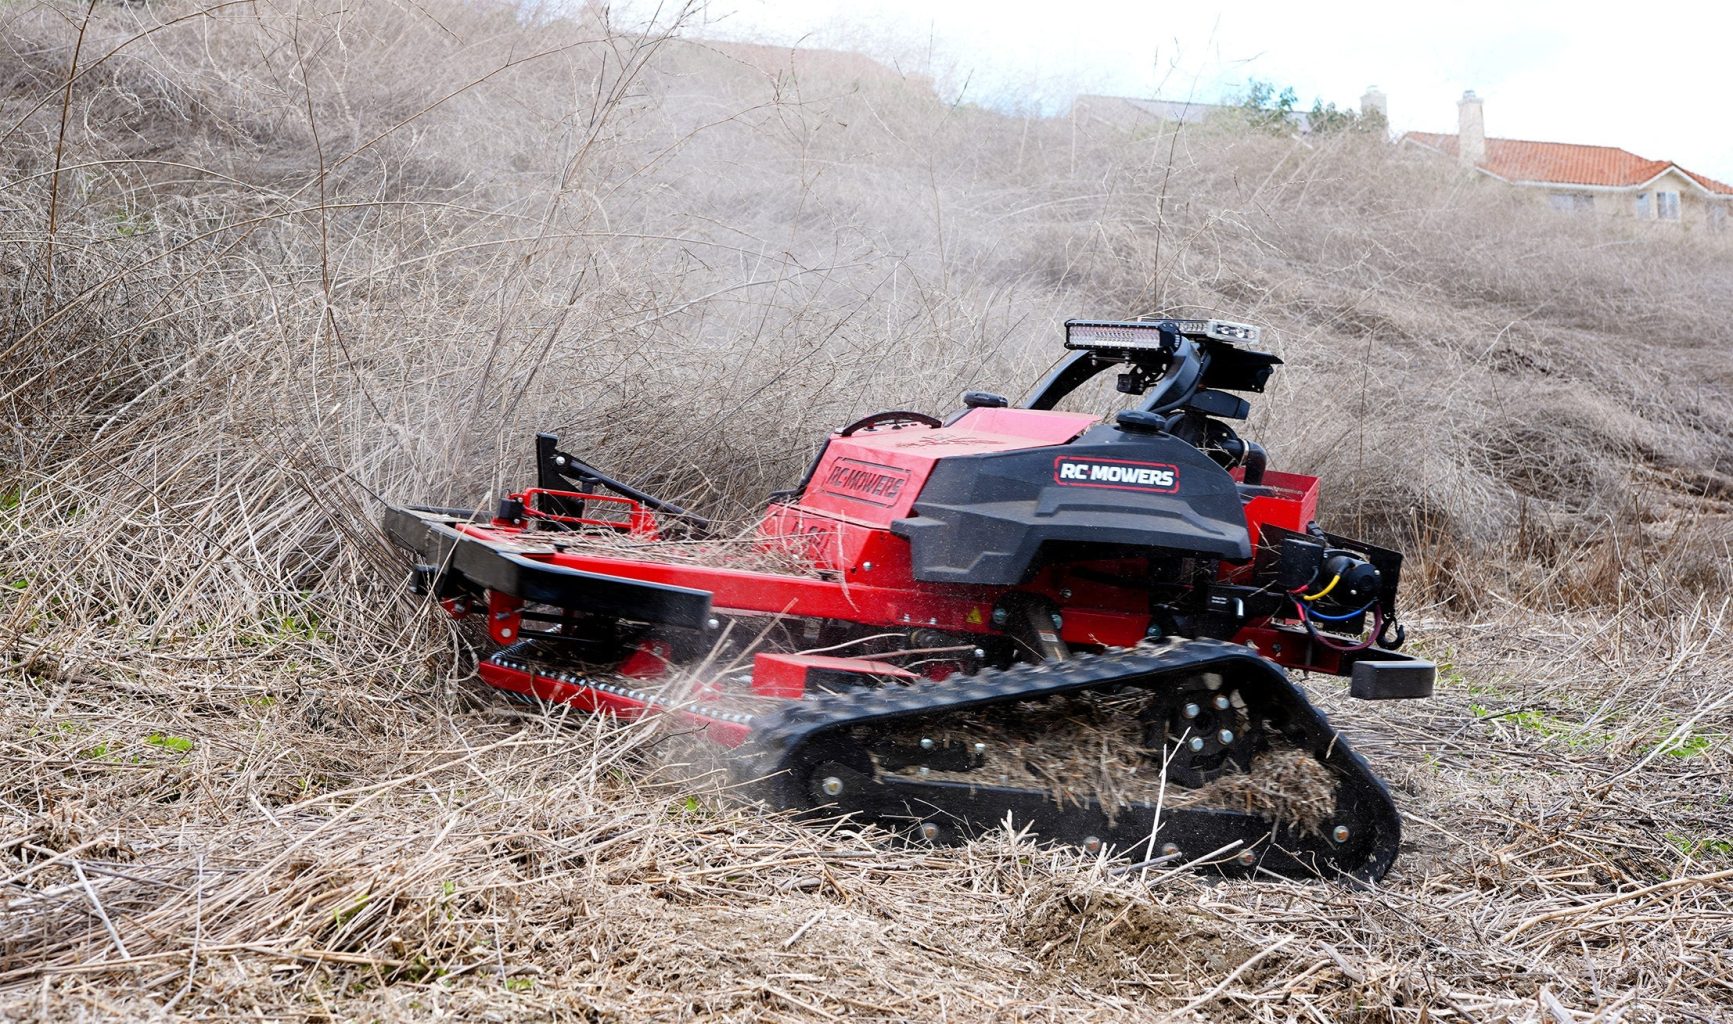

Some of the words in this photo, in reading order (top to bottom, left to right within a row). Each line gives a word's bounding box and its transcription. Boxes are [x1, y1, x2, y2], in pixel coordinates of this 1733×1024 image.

[843, 470, 905, 498] MOWERS
[1060, 463, 1089, 480] RC
[1090, 465, 1174, 486] MOWERS
